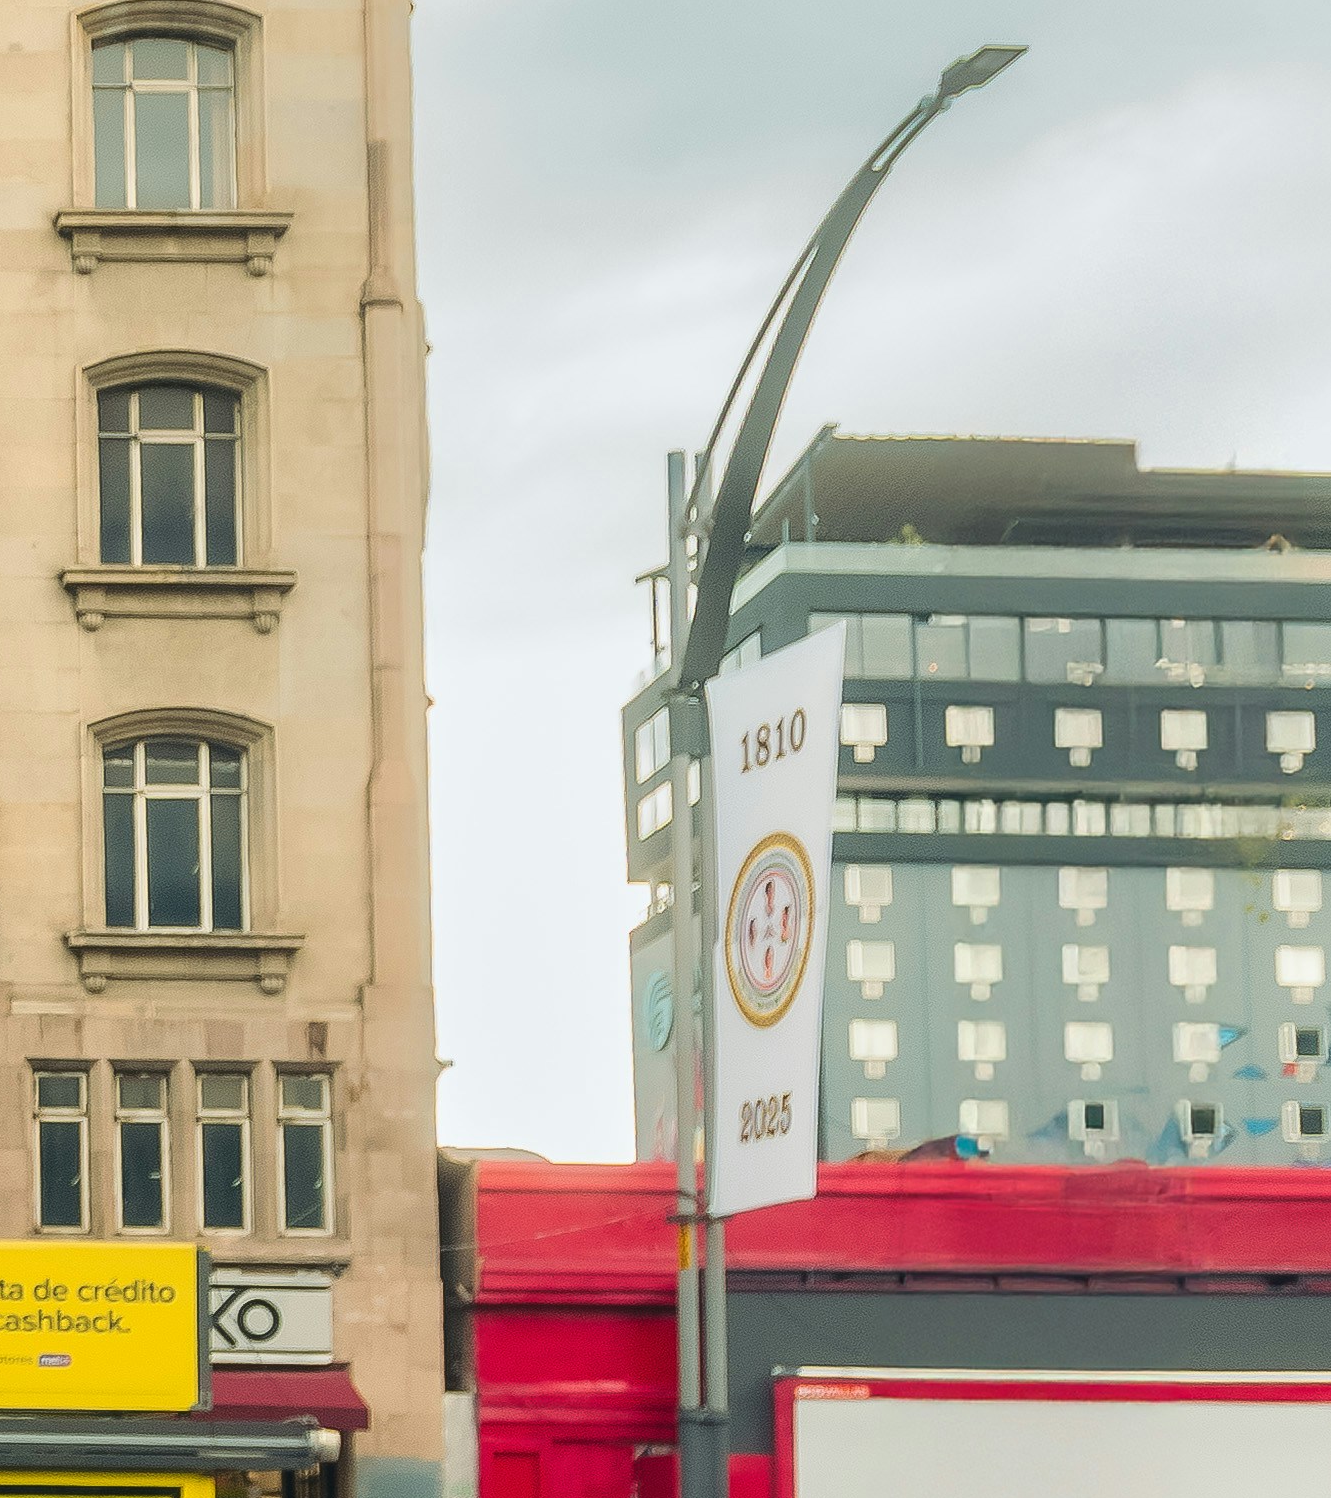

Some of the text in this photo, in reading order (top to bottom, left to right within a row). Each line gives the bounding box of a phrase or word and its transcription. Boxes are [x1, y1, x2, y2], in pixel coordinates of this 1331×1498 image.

[741, 707, 806, 774] 1810
[740, 1091, 793, 1143] 2025
[34, 1277, 67, 1302] de
[77, 1278, 176, 1304] crédito
